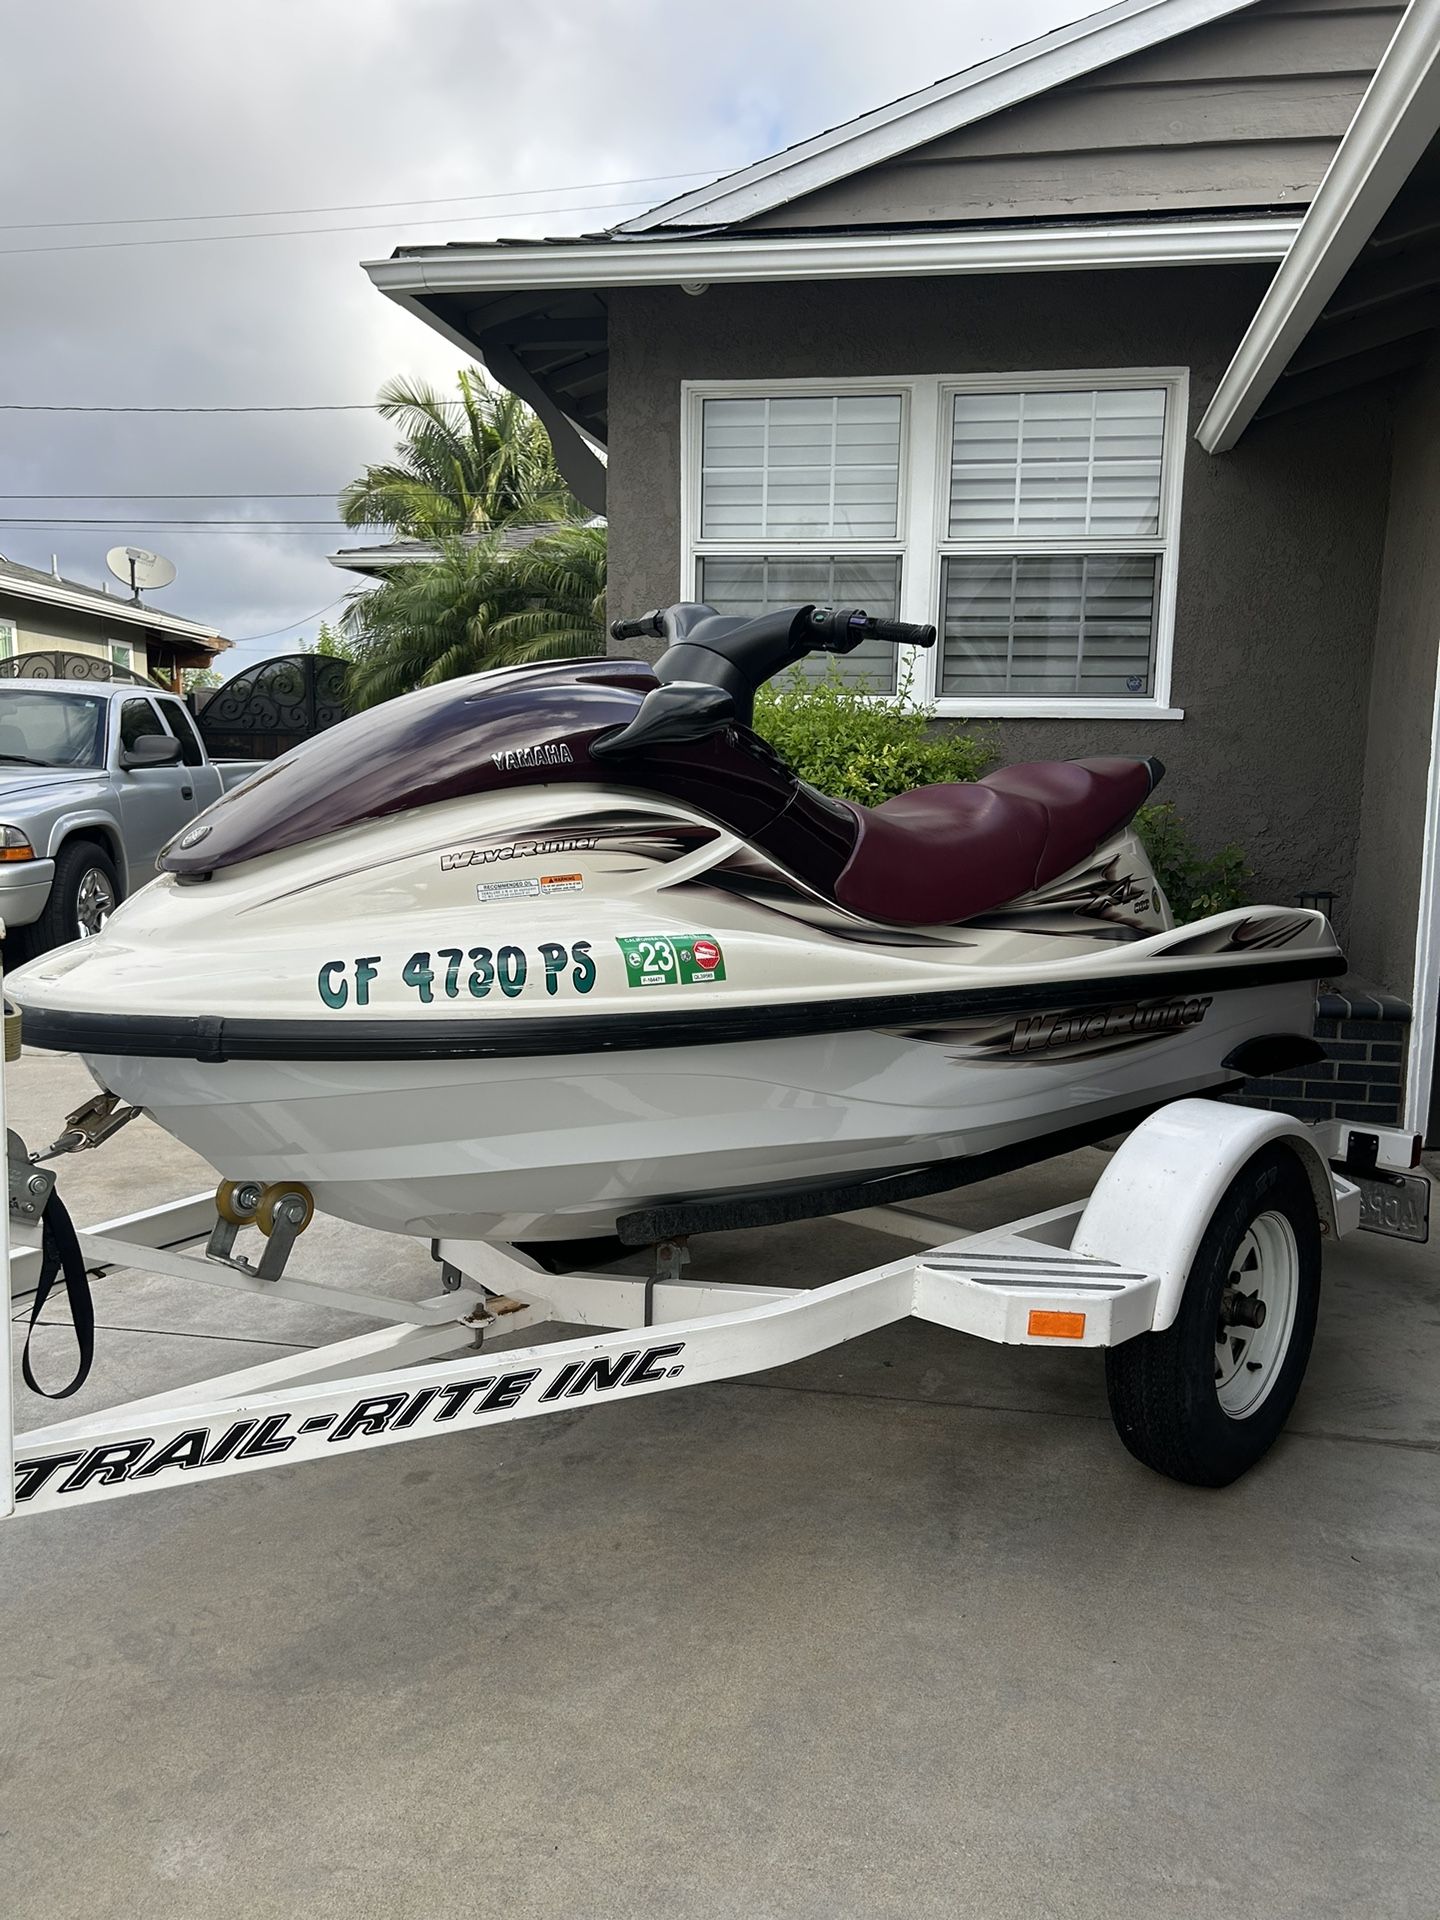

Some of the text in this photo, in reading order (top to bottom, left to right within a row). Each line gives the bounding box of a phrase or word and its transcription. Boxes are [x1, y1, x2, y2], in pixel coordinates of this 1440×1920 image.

[491, 743, 574, 771] YAMAHA
[440, 837, 600, 871] WaveRunner
[318, 940, 597, 1010] CF 4730 PS
[638, 941, 674, 972] 23
[1009, 997, 1213, 1054] WaveRunner
[15, 1341, 686, 1503] TRAIL-RITE INC.
